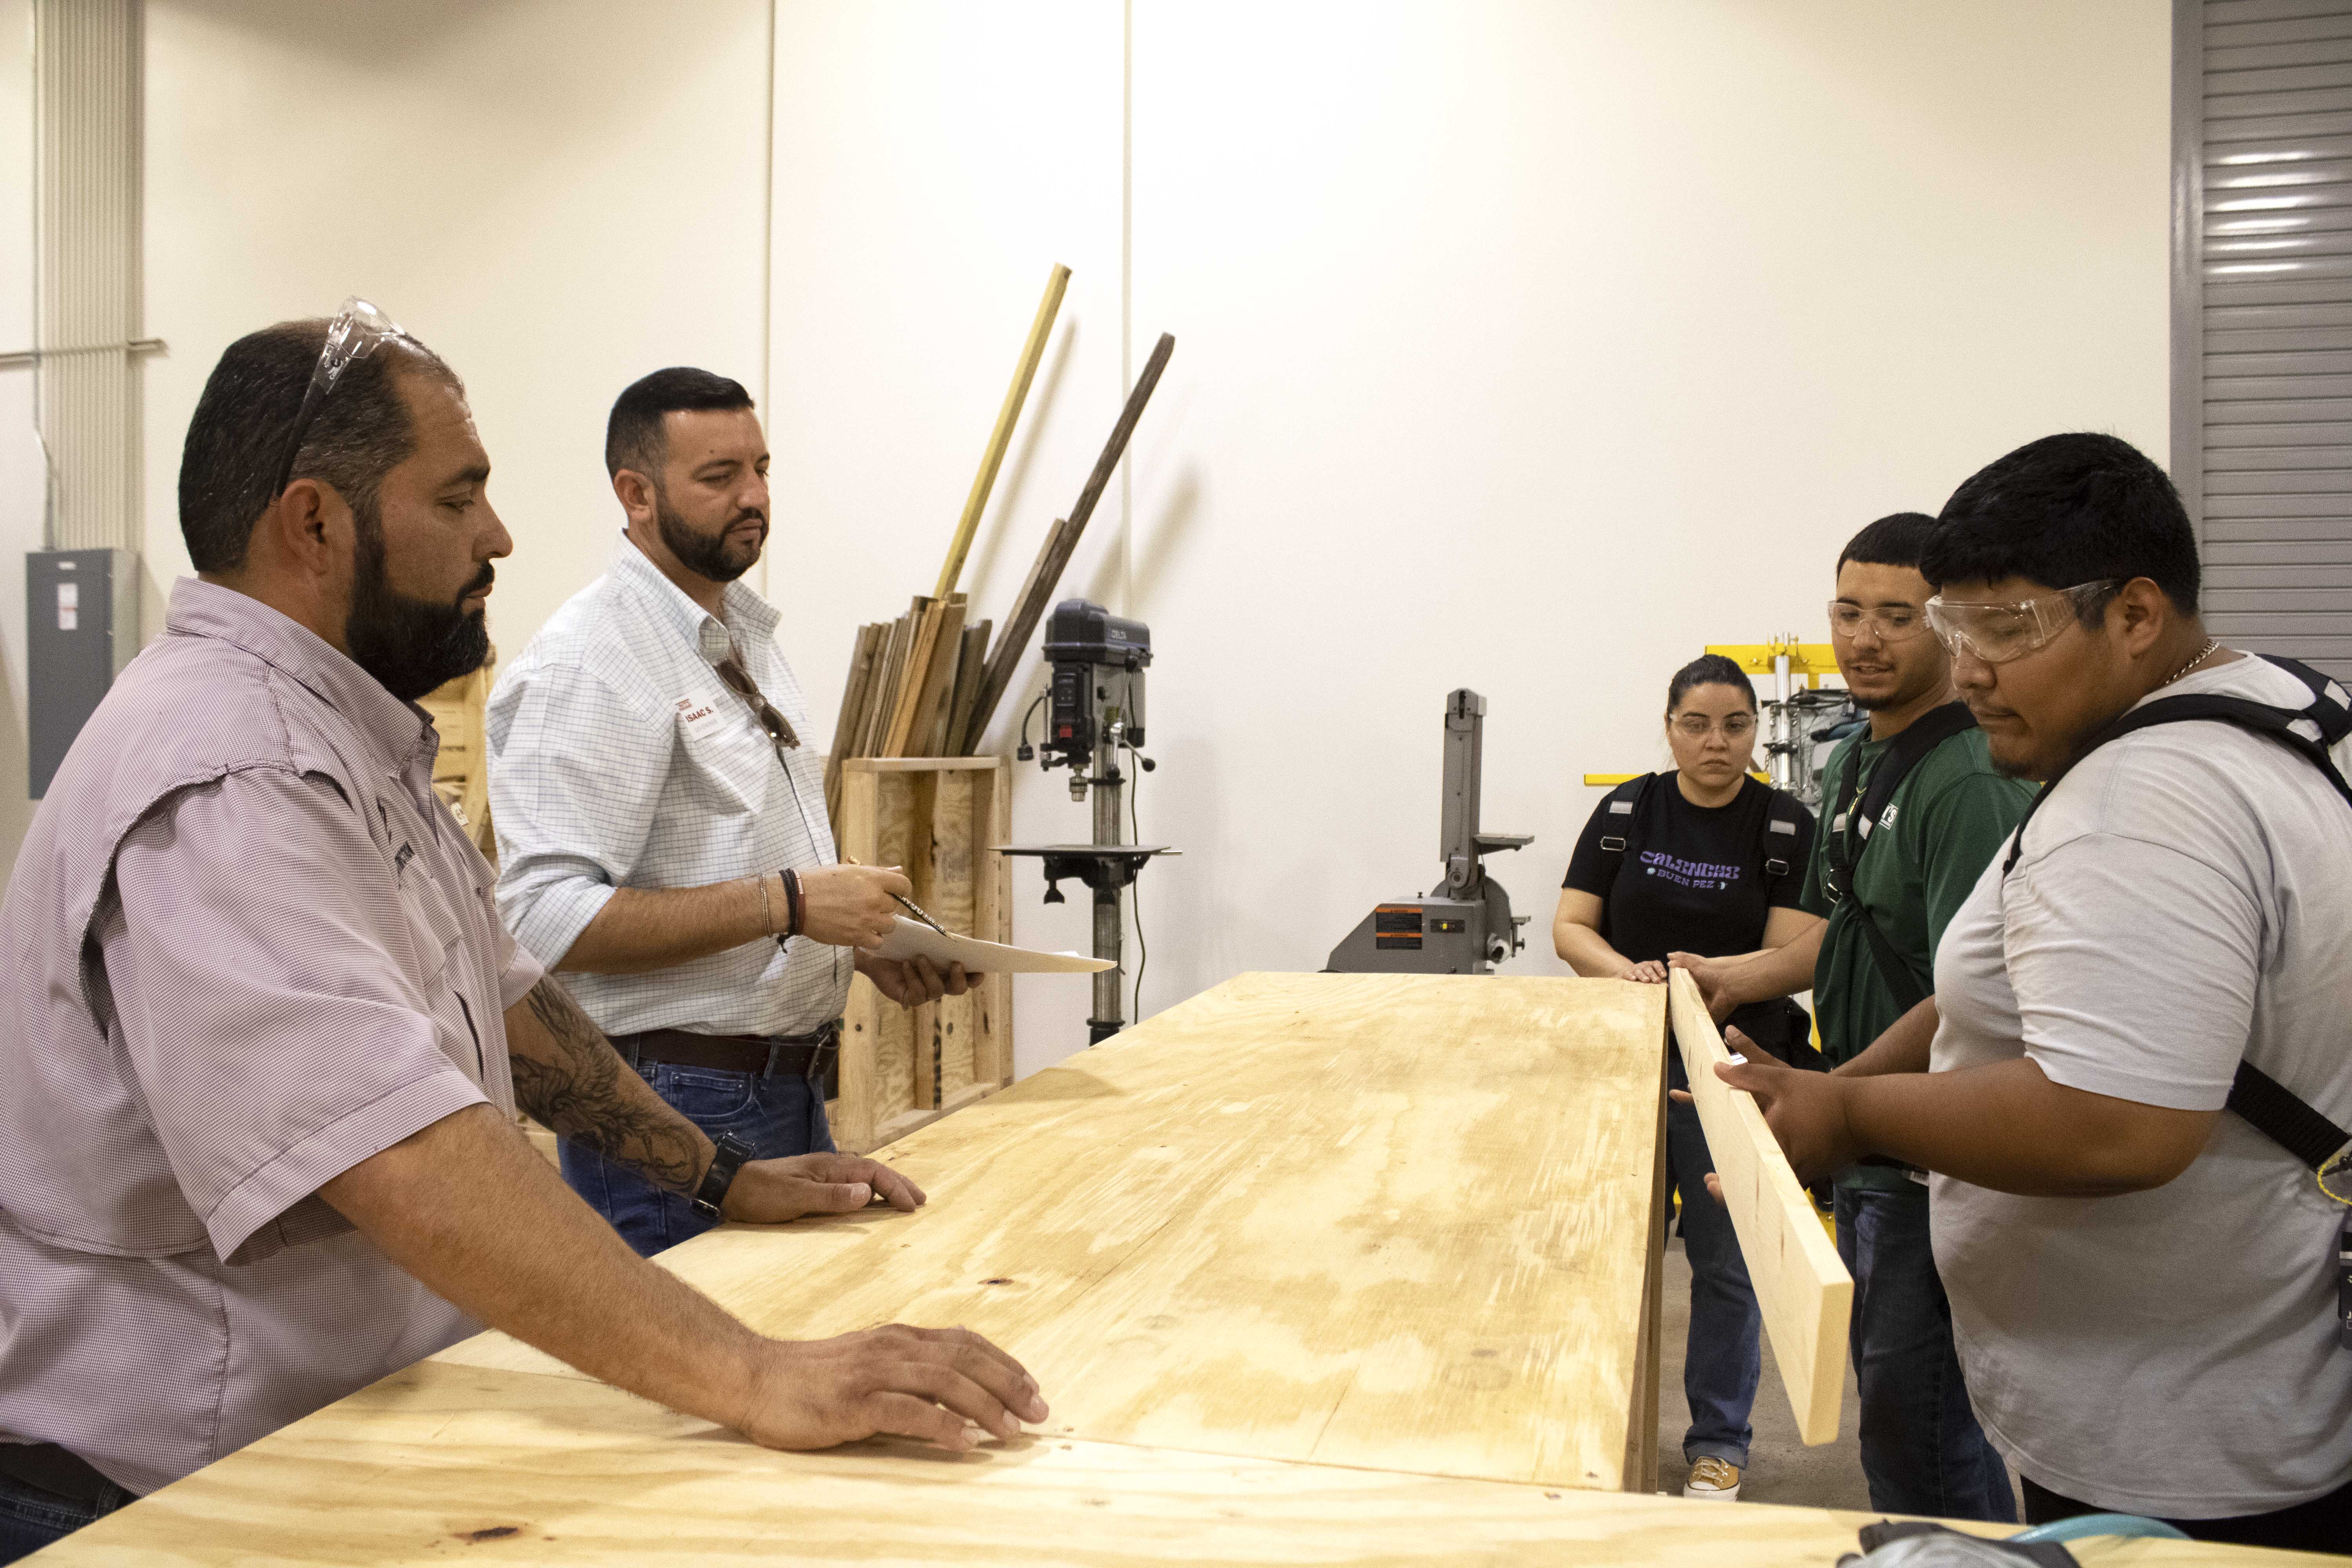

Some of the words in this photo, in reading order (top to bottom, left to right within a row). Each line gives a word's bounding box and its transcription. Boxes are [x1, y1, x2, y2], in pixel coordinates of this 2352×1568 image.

[685, 709, 706, 723] ISAAC
[1657, 869, 1690, 886] BUEN
[1693, 880, 1715, 888] PEZ
